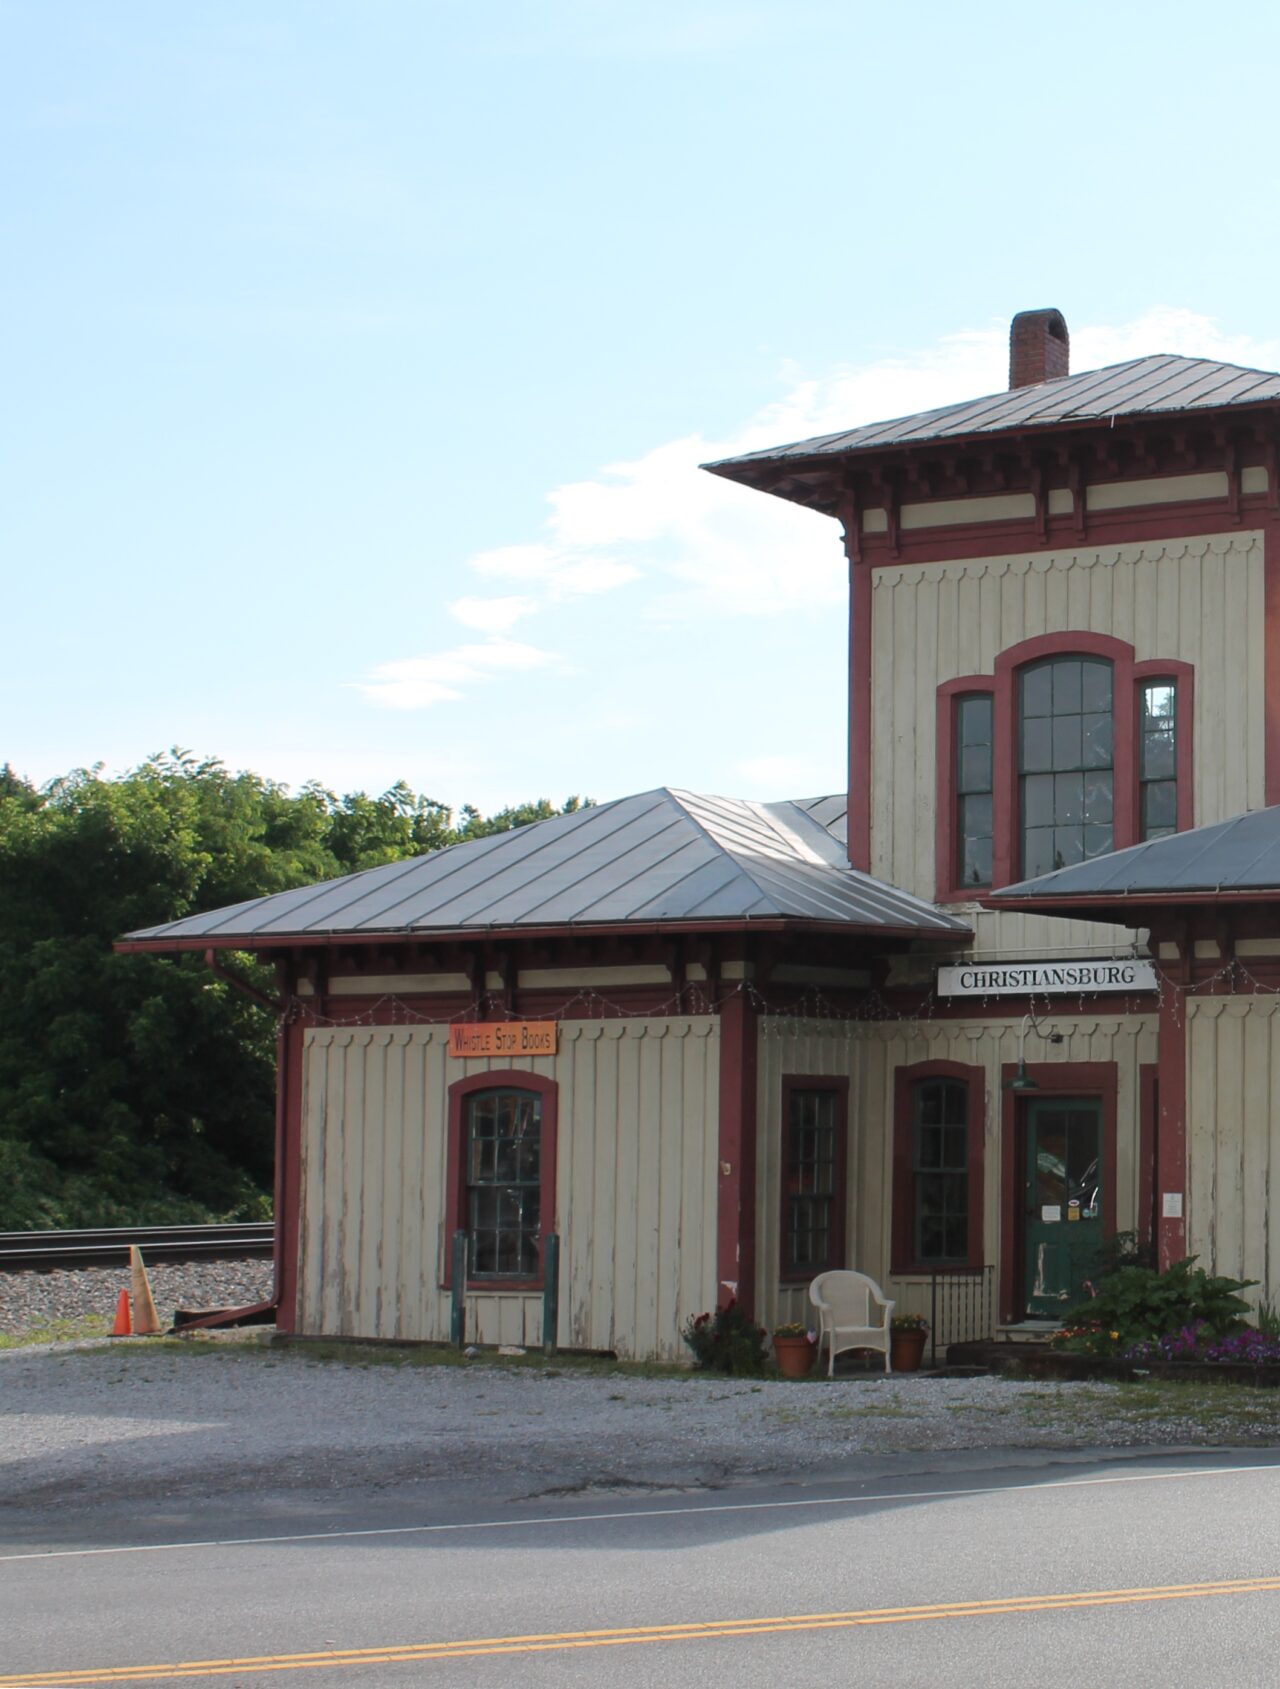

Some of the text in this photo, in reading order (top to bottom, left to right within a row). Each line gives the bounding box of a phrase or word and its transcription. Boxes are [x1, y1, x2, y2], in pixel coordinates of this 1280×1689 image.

[960, 966, 1135, 989] CHRISTIANSBURG
[454, 1026, 551, 1052] WHISTLE STOP BOOKS
